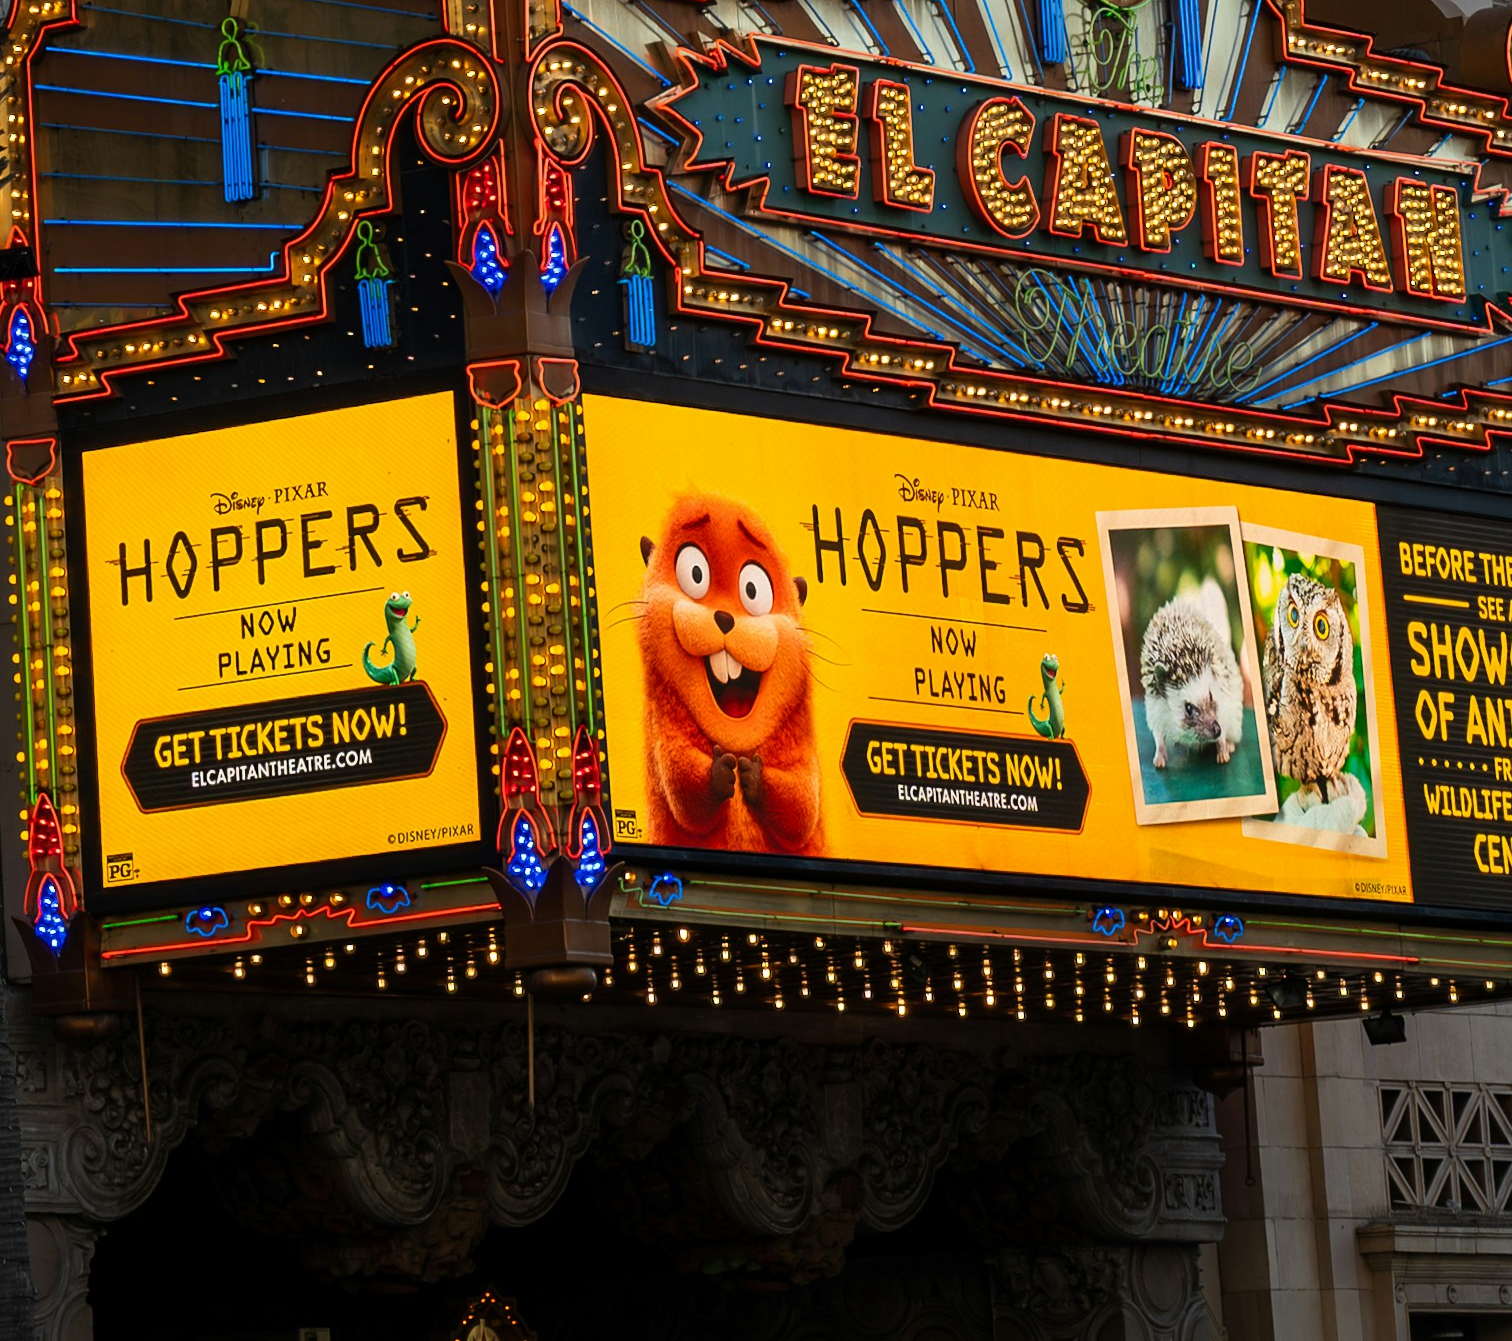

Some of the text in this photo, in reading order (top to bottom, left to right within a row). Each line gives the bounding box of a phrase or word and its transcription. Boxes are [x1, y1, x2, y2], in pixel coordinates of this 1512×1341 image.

[788, 62, 1467, 305] EL CAPITAN
[1013, 267, 1263, 394] Theatre
[209, 481, 329, 515] Disney PIXAR
[894, 473, 1001, 513] Disney PIXAR
[115, 495, 433, 607] HOPPERS
[808, 503, 1093, 615] HOPPERS
[1398, 541, 1478, 583] BEFORE
[240, 606, 297, 640] NOW
[1477, 595, 1506, 622] SEE
[218, 637, 331, 678] PLAYING
[930, 624, 977, 658] NOW
[914, 667, 1007, 704] PLAYING
[1414, 688, 1455, 742] OF
[154, 702, 408, 769] GET TICKETS NOW!
[190, 748, 374, 788] ELCAPITANTHEATRE.COM
[866, 740, 1063, 791] GET TICKETS NOW!
[897, 783, 1039, 813] ELCAPITANTHEATRE.COM
[617, 819, 636, 835] PG
[109, 863, 131, 879] PG
